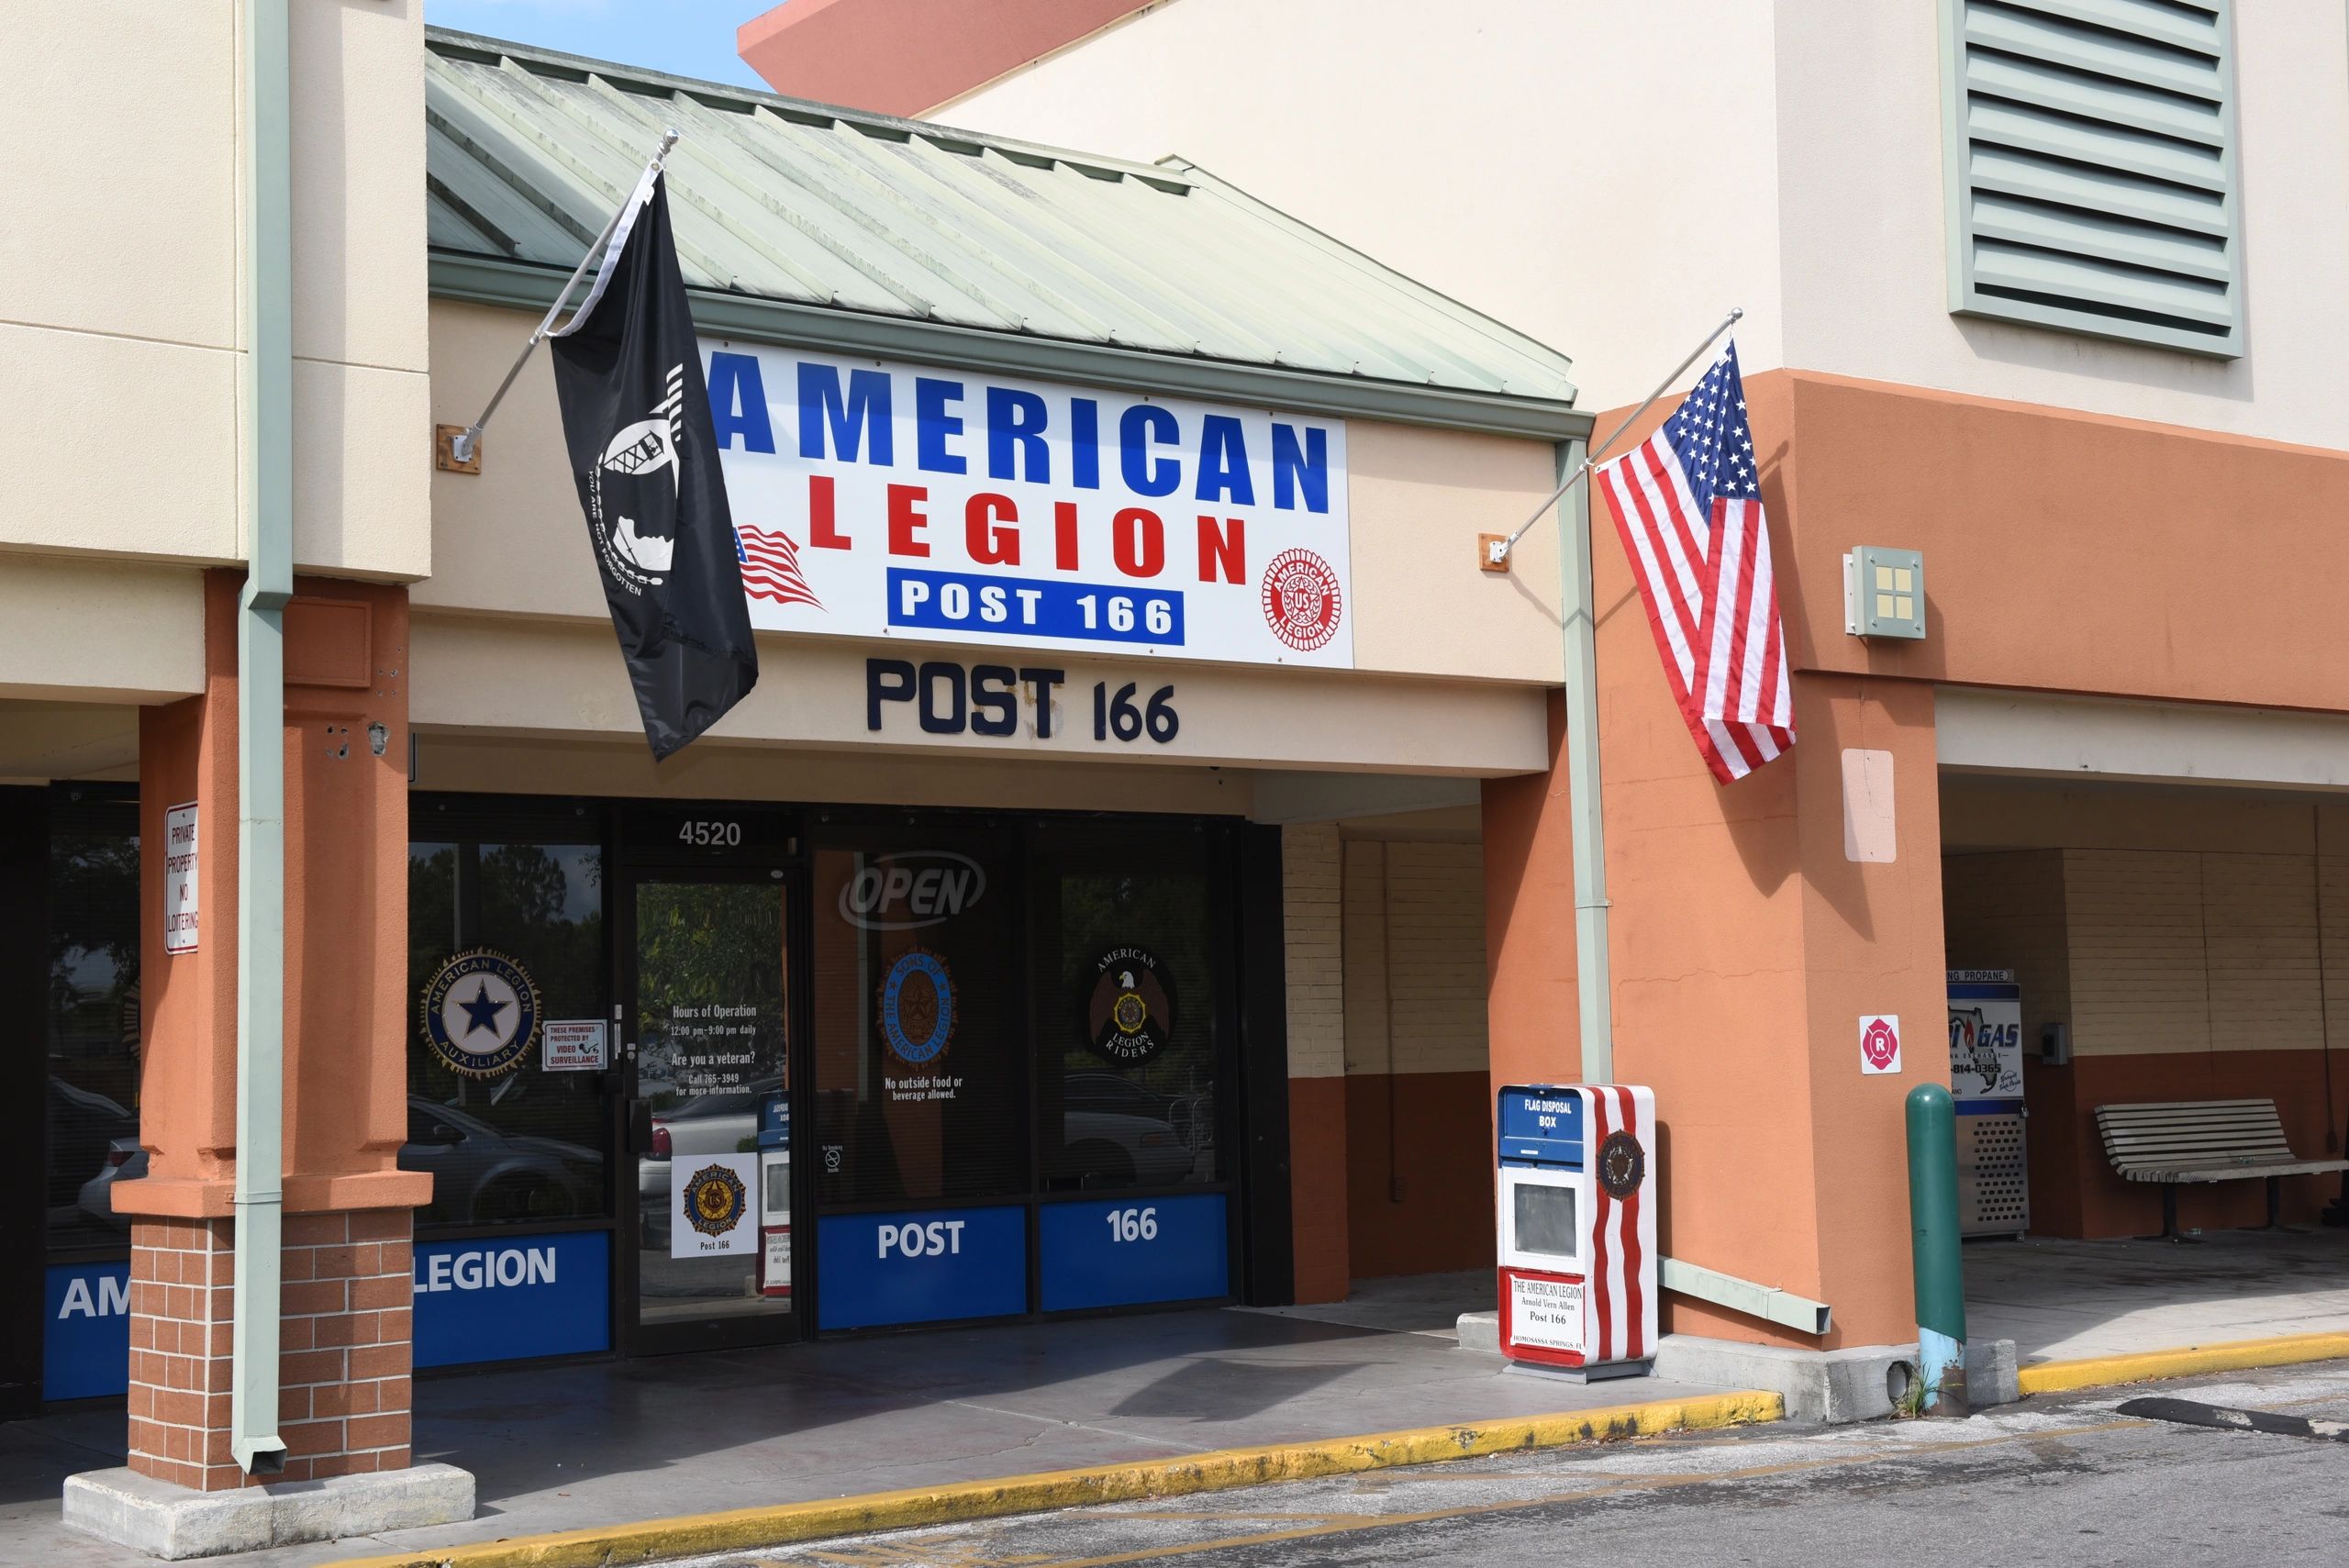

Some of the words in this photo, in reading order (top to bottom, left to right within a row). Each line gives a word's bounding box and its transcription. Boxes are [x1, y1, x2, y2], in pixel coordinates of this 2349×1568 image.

[708, 350, 1328, 514] AMERICAN
[809, 474, 1246, 585] LEGION
[595, 523, 605, 546] NOT
[602, 547, 642, 596] FORGOTTEN
[1274, 562, 1330, 595] AMERICAN
[902, 579, 1042, 626] POST
[1076, 595, 1171, 634] 166
[1295, 592, 1309, 608] US
[1280, 616, 1323, 638] LEGION
[866, 658, 1064, 738] POST
[1094, 681, 1179, 743] 166
[173, 824, 195, 844] PRIVATE
[679, 821, 740, 846] 4520
[168, 852, 198, 873] PROPERTY
[179, 884, 188, 902] NO
[849, 867, 971, 915] OPEN
[168, 912, 198, 932] LOITERING
[896, 956, 925, 976] SONS
[928, 962, 942, 977] OF
[1097, 948, 1156, 973] AMERICAN
[1965, 972, 2004, 981] PROPANE
[430, 960, 489, 1015] AMERICAN
[496, 964, 531, 1013] LEGION
[673, 1006, 699, 1018] Hours
[701, 1005, 711, 1018] of
[714, 1004, 757, 1019] Operation
[671, 1026, 690, 1036] 12:00
[726, 1027, 737, 1037] pm
[740, 1025, 756, 1036] daily
[887, 1023, 932, 1060] AMERICAN
[933, 997, 950, 1046] LEGION
[1977, 1024, 2020, 1048] GAS
[1112, 1031, 1149, 1048] LEGION
[1876, 1038, 1886, 1051] R
[440, 1041, 519, 1067] AUXILIARY
[557, 1045, 576, 1053] VIDEO
[1106, 1040, 1154, 1058] RIDERS
[551, 1056, 599, 1064] SURVEILLANCE
[672, 1053, 687, 1066] Are
[690, 1055, 706, 1067] you
[708, 1054, 714, 1064] a
[717, 1051, 756, 1064] veteran?
[688, 1074, 702, 1084] Call
[704, 1073, 740, 1084] 765-3949
[885, 1077, 896, 1090] No
[898, 1076, 930, 1089] outside
[932, 1075, 952, 1088] food
[953, 1077, 963, 1087] or
[675, 1086, 686, 1096] for
[689, 1087, 707, 1095] more
[709, 1084, 752, 1095] information.
[892, 1090, 922, 1102] beverage
[928, 1089, 956, 1100] allowed.
[1524, 1098, 1541, 1111] FLAG
[1542, 1101, 1572, 1114] DISPOSAL
[1539, 1115, 1556, 1128] BOX
[692, 1172, 739, 1193] AMERICAN
[698, 1218, 732, 1230] LEGION
[1107, 1207, 1157, 1242] 166
[700, 1240, 716, 1251] Post
[718, 1240, 730, 1250] 166
[878, 1221, 964, 1259] POST
[413, 1247, 556, 1294] LEGION
[1514, 1281, 1525, 1294] THE
[1527, 1282, 1558, 1296] AMERICAN
[1559, 1285, 1582, 1299] LEGION
[1521, 1296, 1542, 1307] Arnold
[1542, 1299, 1557, 1309] Vern
[1558, 1301, 1575, 1311] Allen
[1530, 1311, 1548, 1322] Post
[1551, 1314, 1566, 1325] 166
[1513, 1334, 1548, 1344] HOMOSASSA
